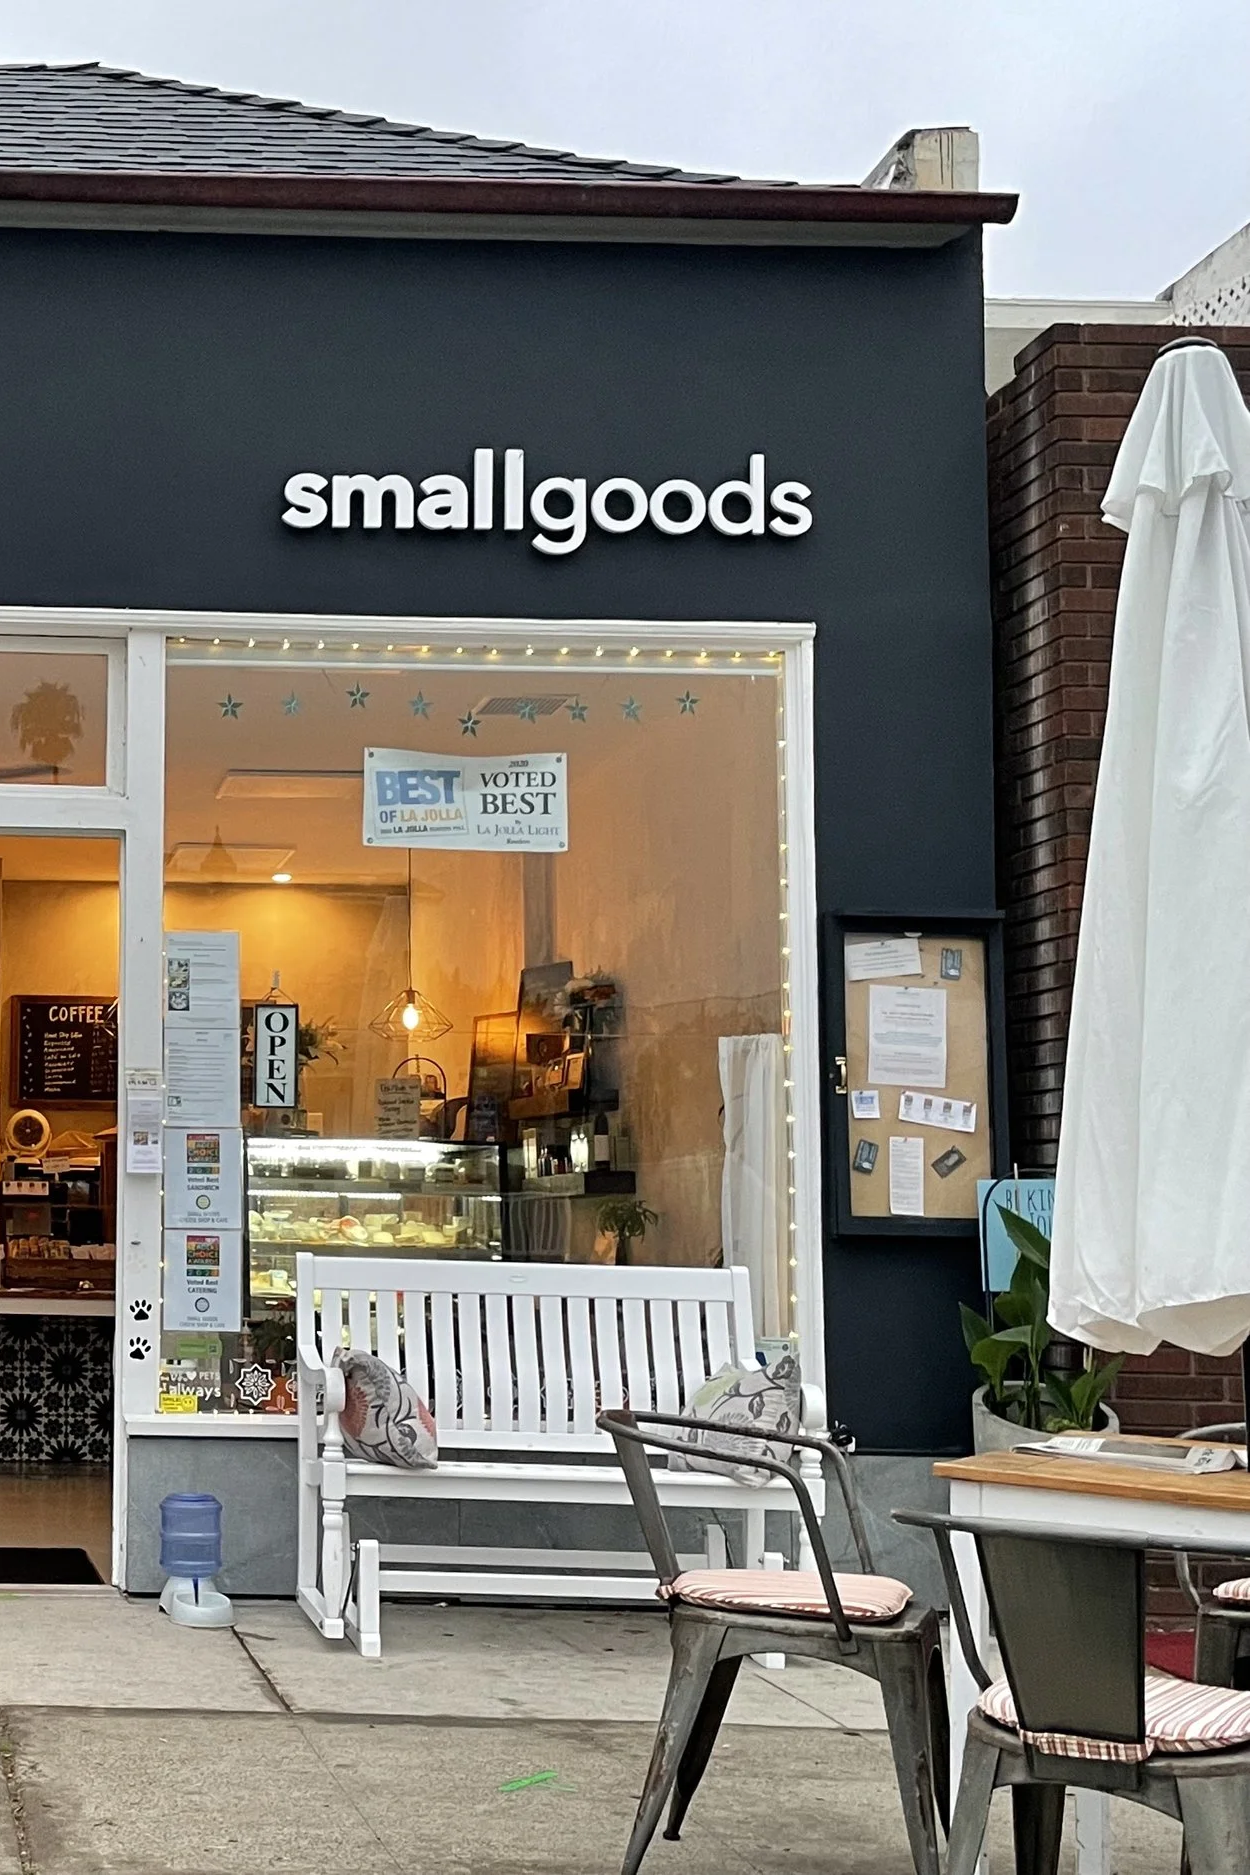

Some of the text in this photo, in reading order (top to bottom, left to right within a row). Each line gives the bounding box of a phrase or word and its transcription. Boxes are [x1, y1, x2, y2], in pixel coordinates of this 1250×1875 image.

[281, 447, 814, 556] smallgoods
[376, 769, 461, 806] BEST
[480, 771, 556, 788] VOTED
[480, 792, 557, 815] BEST
[379, 808, 463, 823] OF LA JOLLA
[477, 824, 559, 836] LA JOLLA LIGHT
[48, 1005, 104, 1023] COFFEE
[264, 1011, 290, 1104] OPEN
[169, 1382, 221, 1401] always
